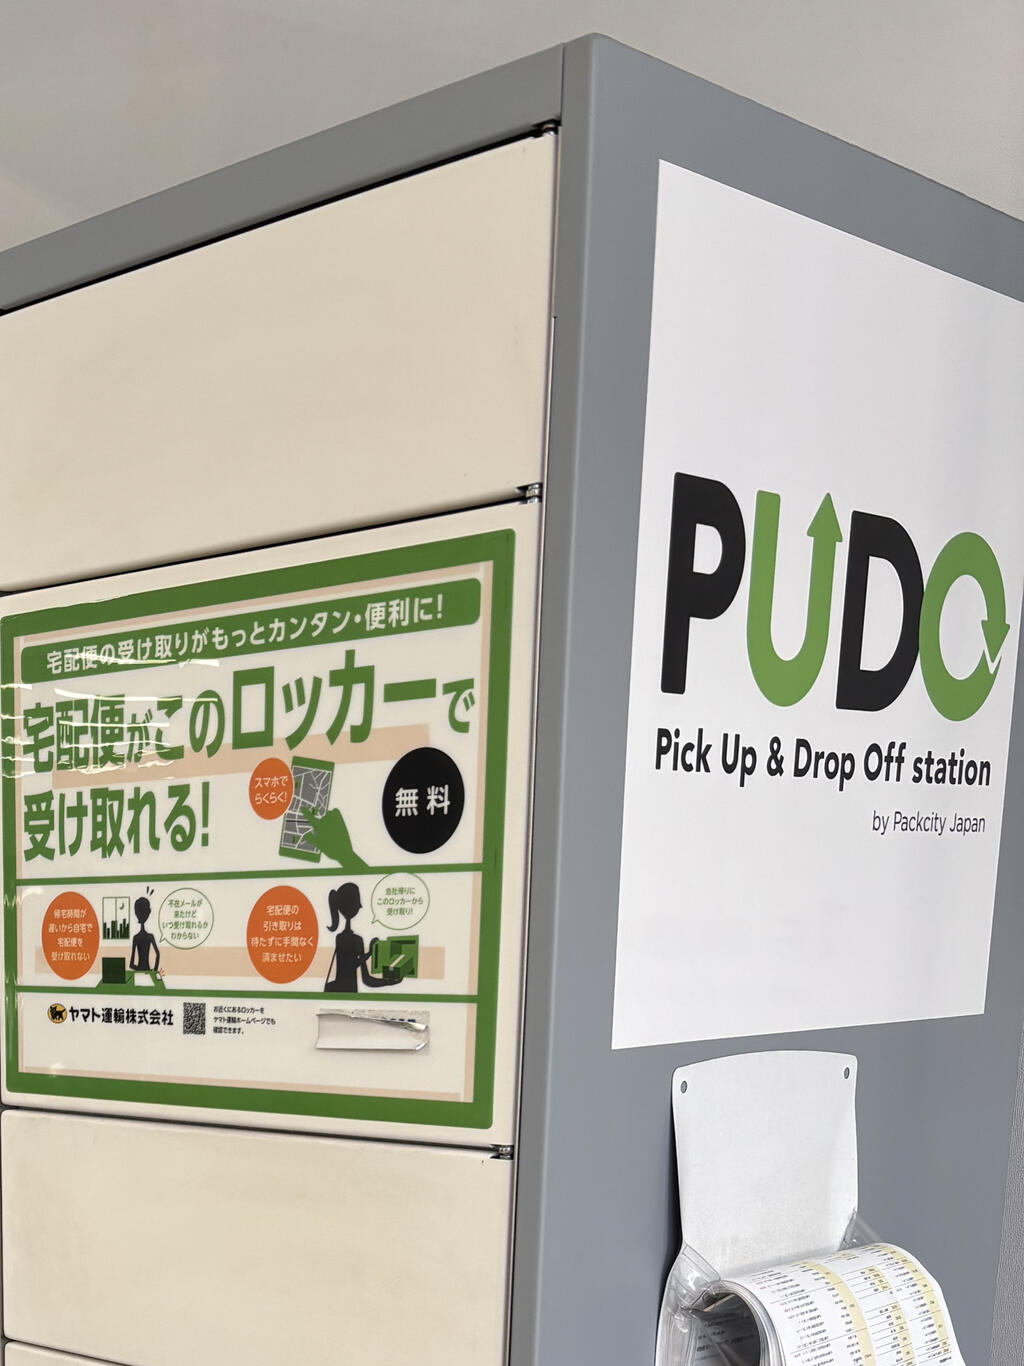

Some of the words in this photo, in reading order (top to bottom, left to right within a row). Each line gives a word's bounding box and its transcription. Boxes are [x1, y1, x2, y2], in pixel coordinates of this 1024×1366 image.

[661, 472, 1011, 722] PUDO
[23, 649, 476, 774] 宅配便がこのロッカーで
[655, 727, 712, 774] Pick
[721, 733, 757, 787] Up
[766, 736, 784, 777] &
[793, 738, 855, 792] Drop
[863, 741, 907, 783] Off
[911, 748, 991, 786] station
[255, 776, 288, 788] スマホで
[255, 791, 288, 805] らくらく!
[395, 784, 451, 817] 無料
[23, 781, 210, 863] 受け取れる!
[872, 810, 889, 834] by
[893, 811, 946, 837] Packcity
[949, 813, 986, 833] Japan
[266, 904, 300, 916] 宅配便の
[263, 920, 302, 932] 引き取りは
[68, 1006, 174, 1026] ヤマト運輸株式会社
